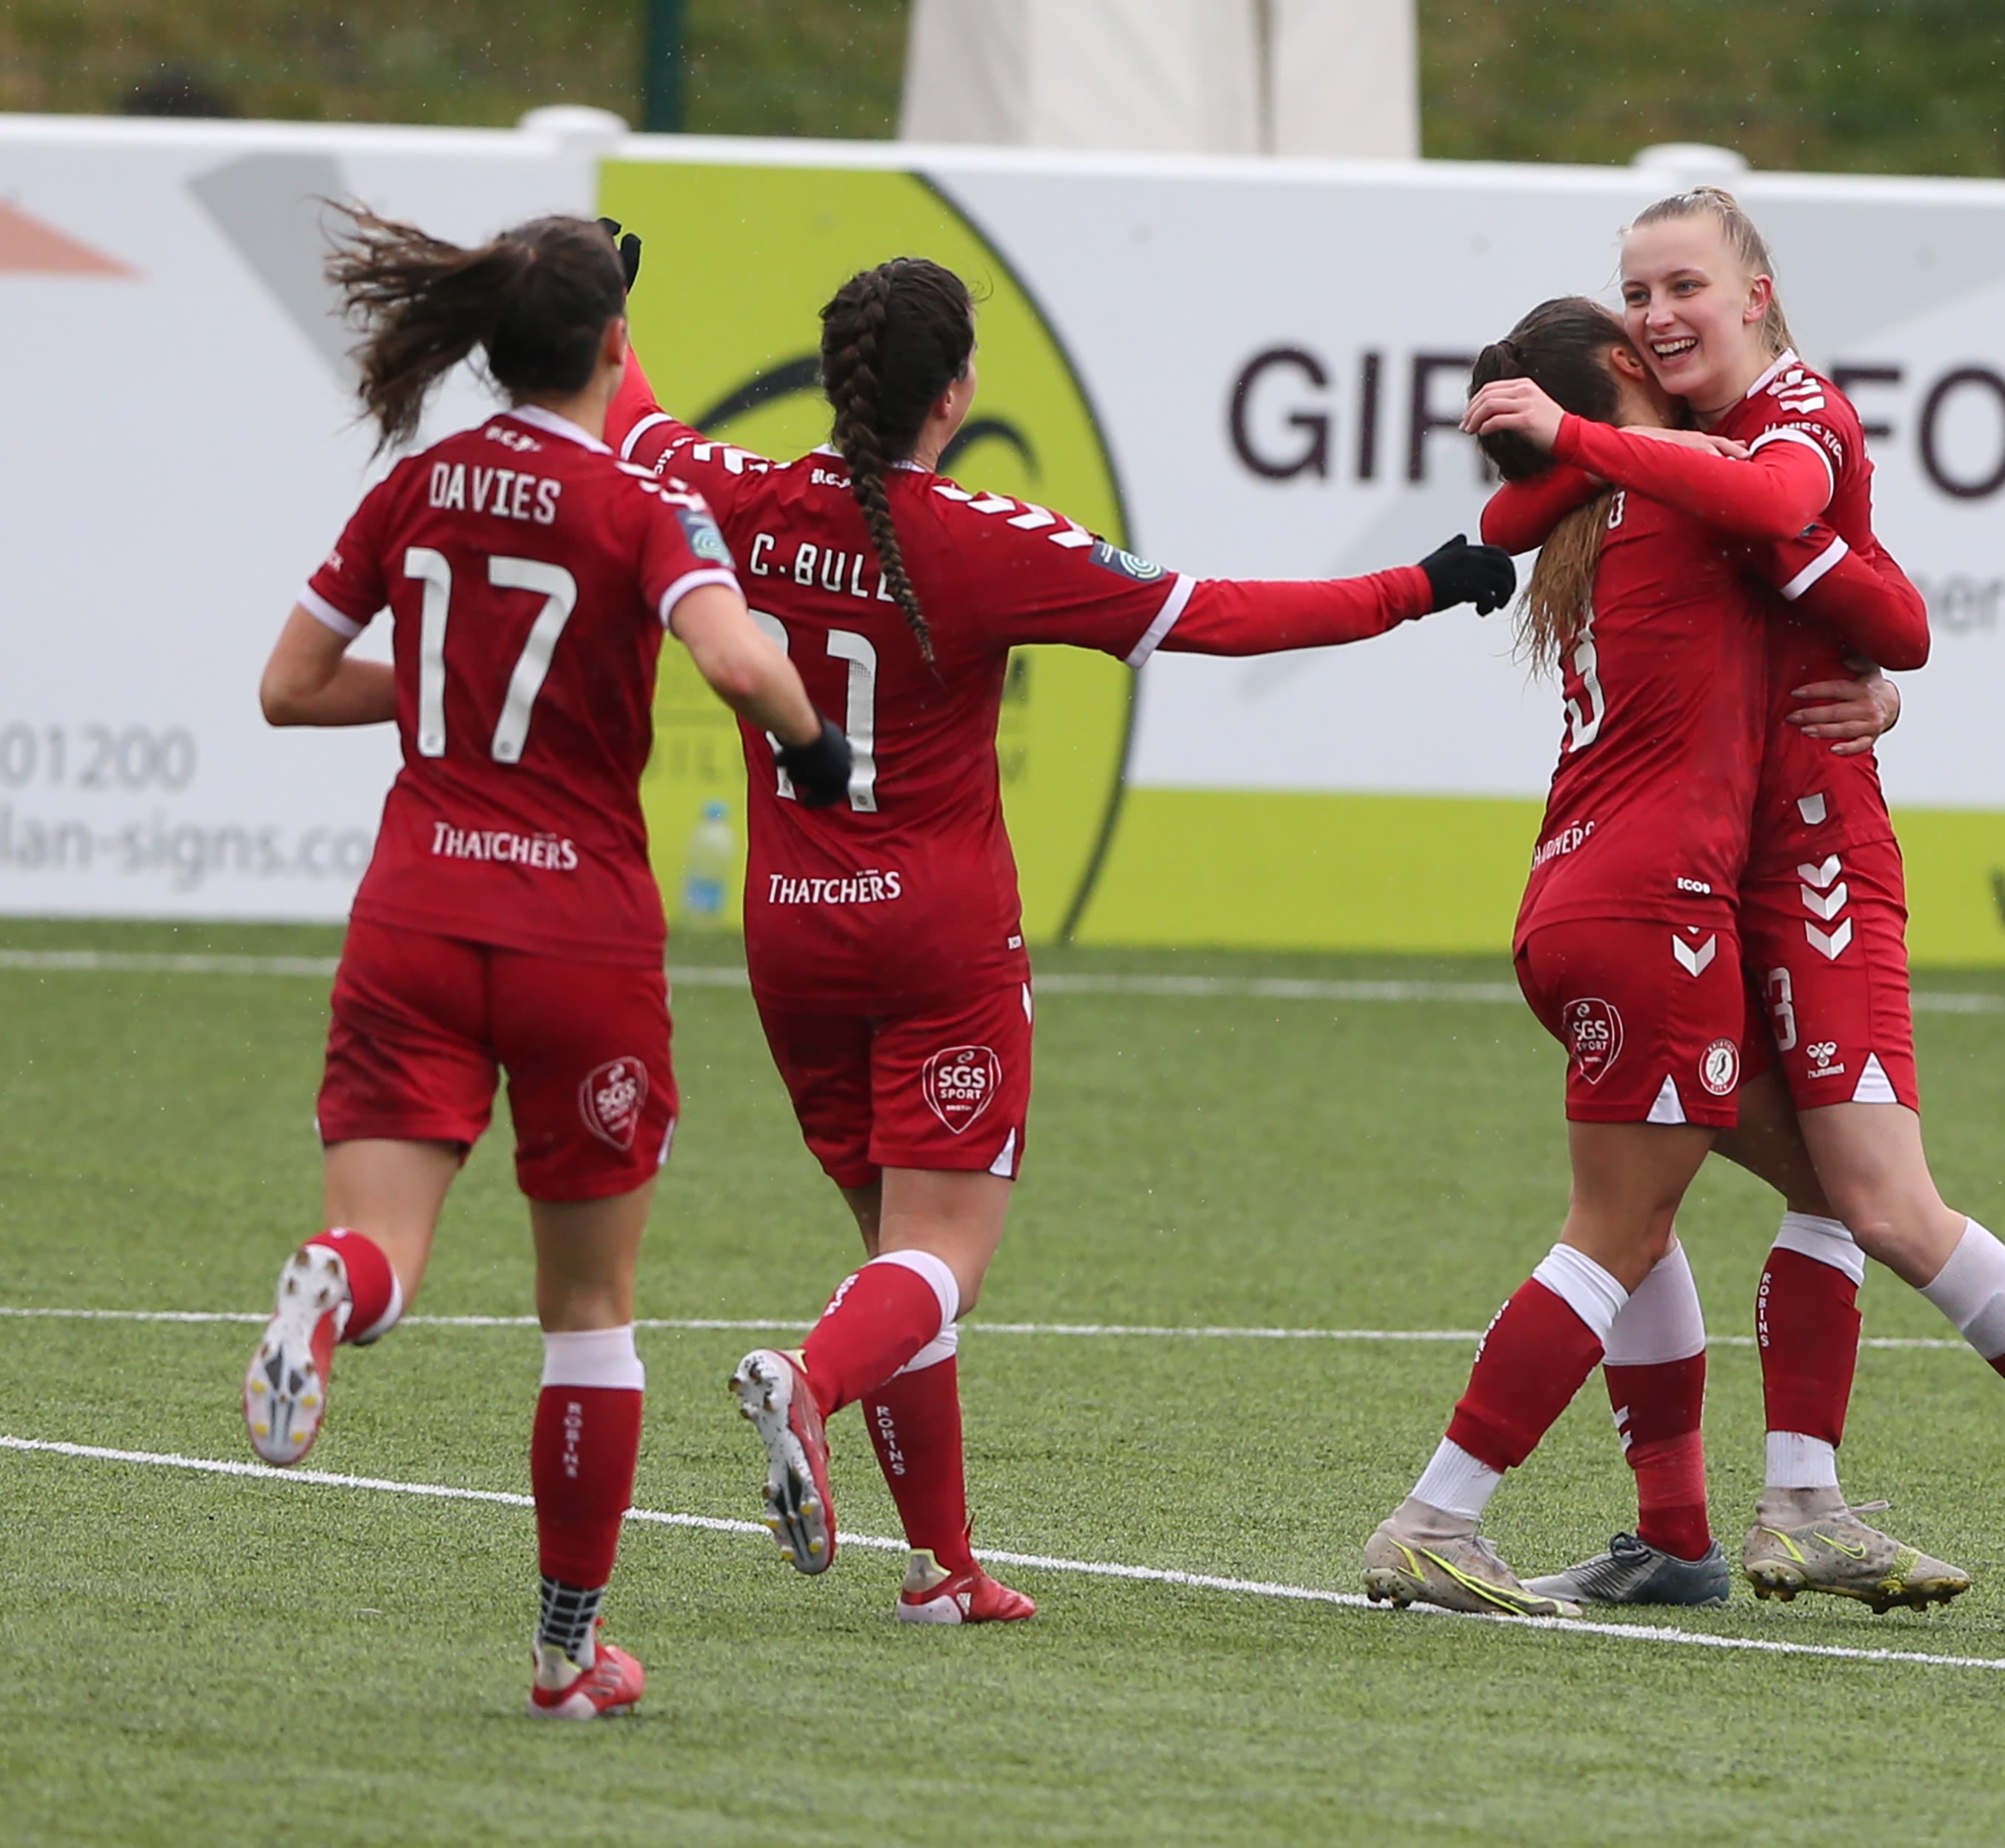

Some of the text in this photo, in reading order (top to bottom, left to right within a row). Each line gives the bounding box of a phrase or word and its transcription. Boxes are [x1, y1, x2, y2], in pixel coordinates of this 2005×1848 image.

[430, 461, 562, 526] DAVIES
[404, 546, 577, 764] 17
[432, 821, 579, 871] THATCHERS
[768, 870, 902, 905] THATCHERS
[1572, 1020, 1609, 1041] SGS
[938, 1065, 986, 1089] SGS
[940, 1088, 982, 1100] SPORT
[1758, 1272, 1772, 1347] ROBINS
[562, 1401, 583, 1478] ROBINS
[876, 1405, 905, 1475] ROBINS
